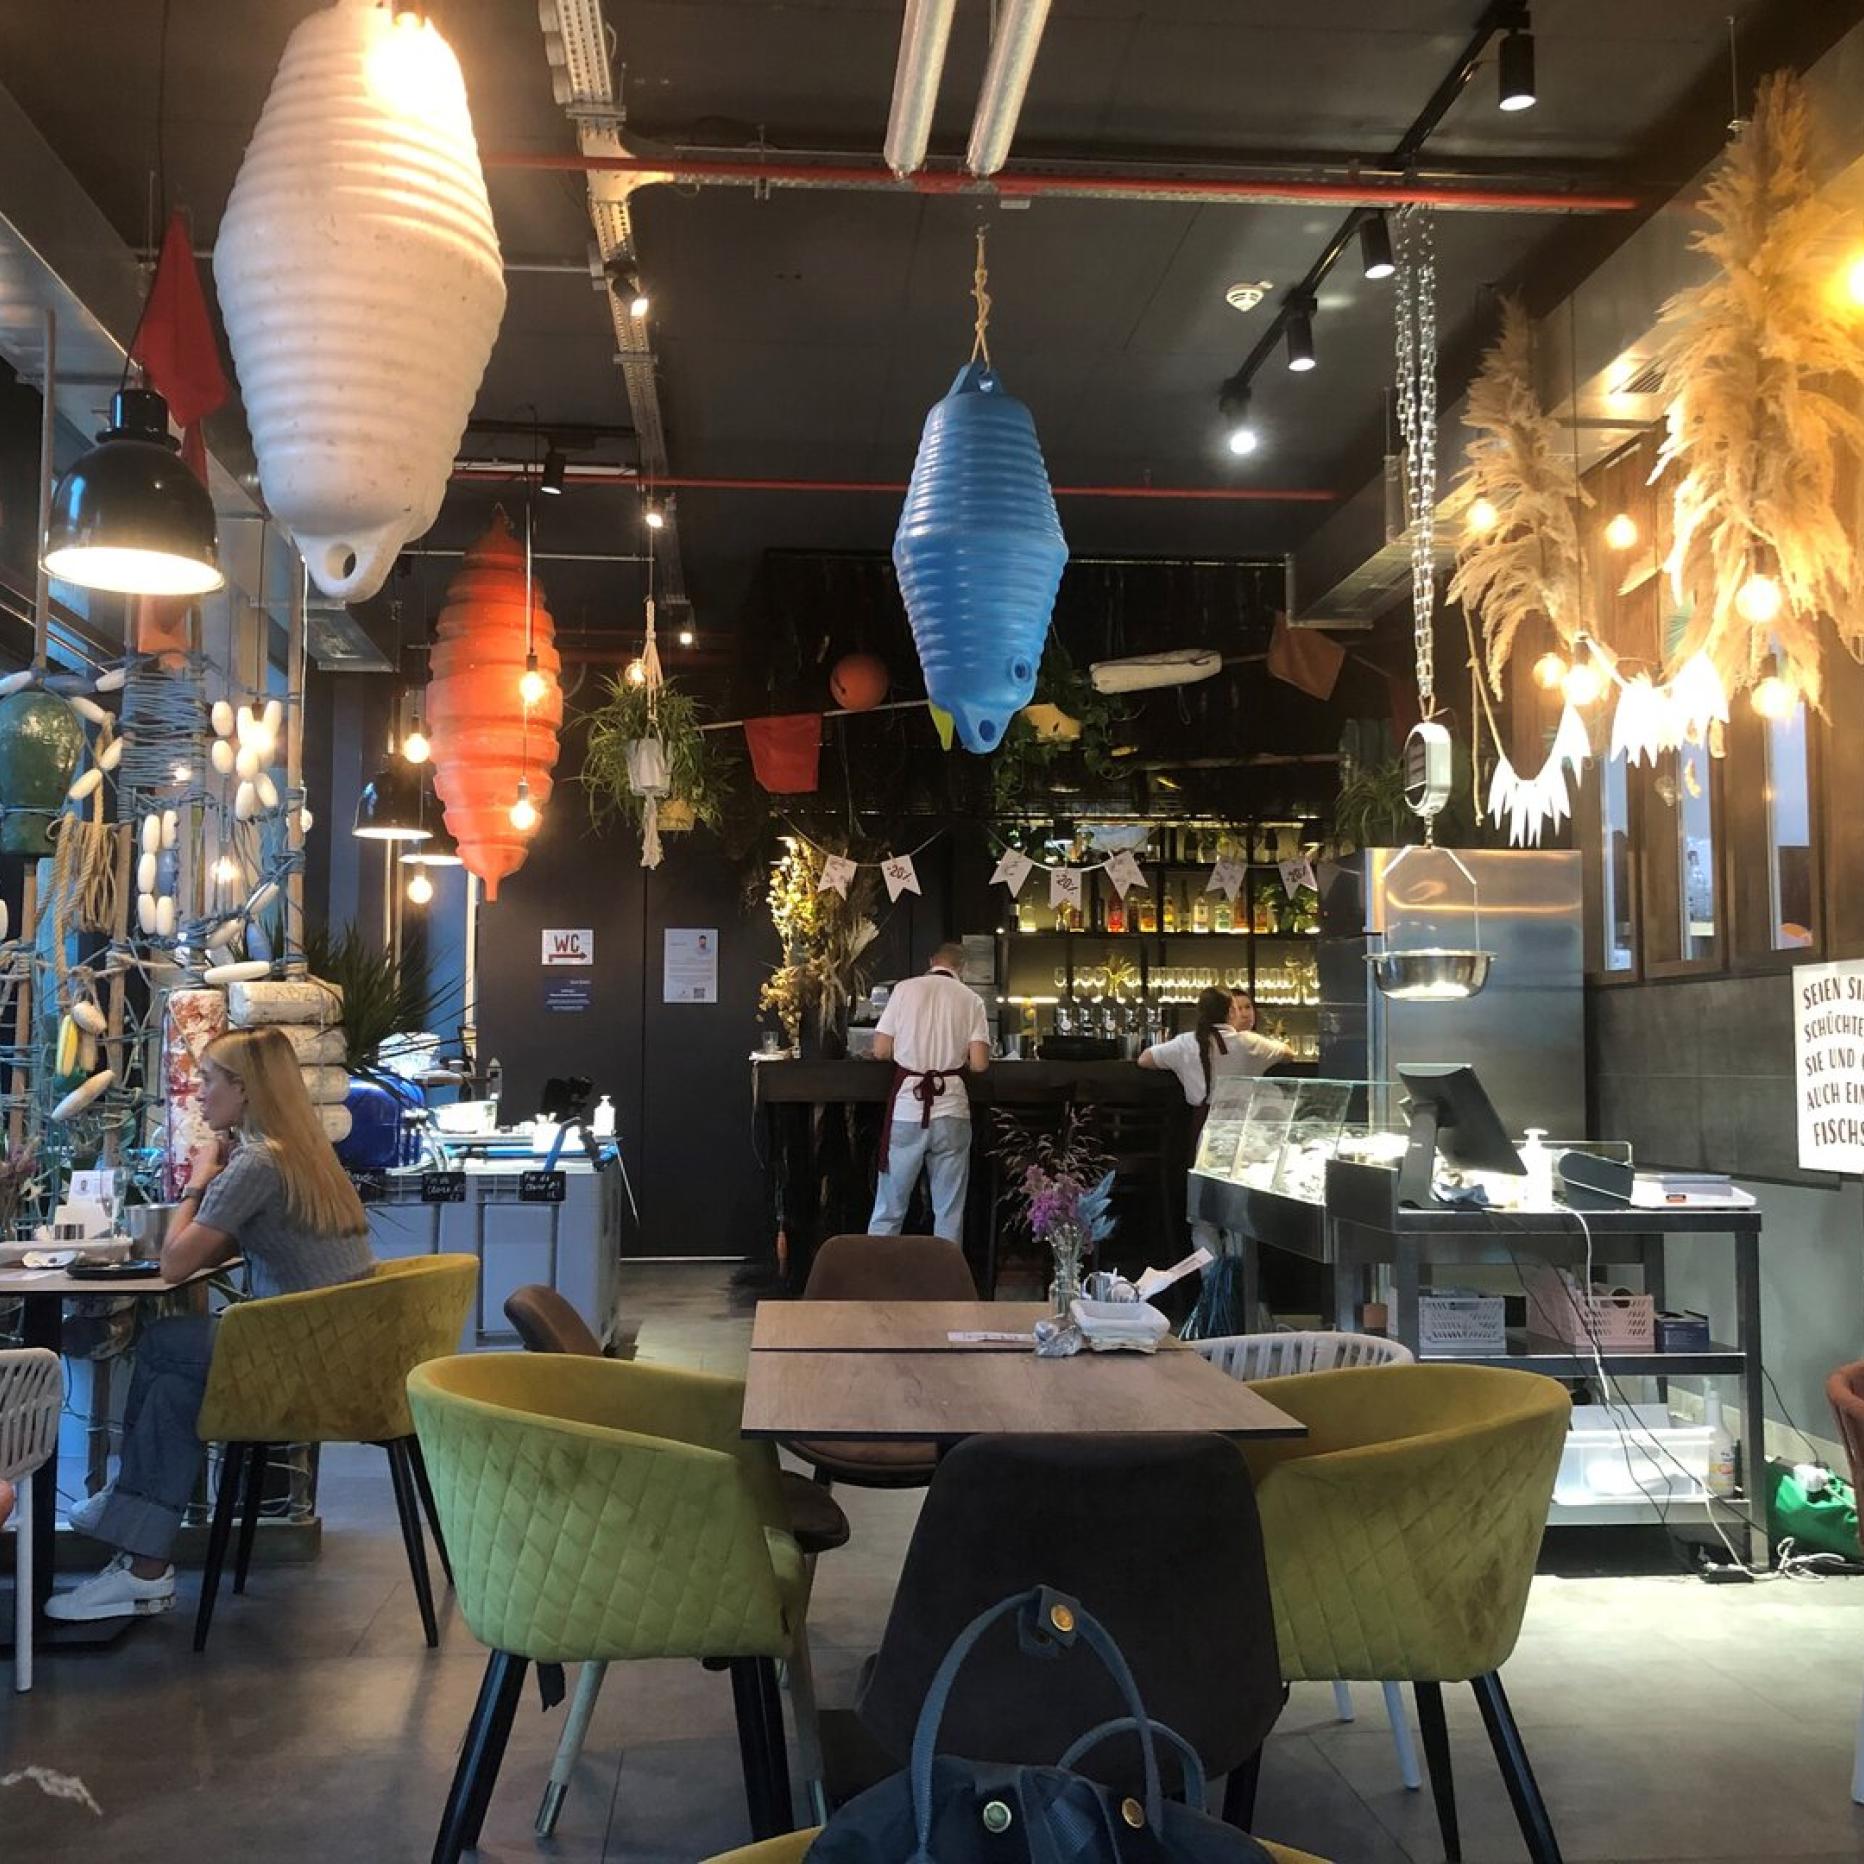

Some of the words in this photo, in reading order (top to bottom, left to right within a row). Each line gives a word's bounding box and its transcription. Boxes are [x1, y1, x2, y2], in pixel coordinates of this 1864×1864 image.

[553, 933, 580, 953] WC
[1803, 976, 1841, 1010] SEIEN
[1847, 976, 1864, 1001] SI
[1805, 1051, 1824, 1077] SIE
[1828, 1048, 1855, 1069] UND
[1806, 1081, 1840, 1112] AUCH
